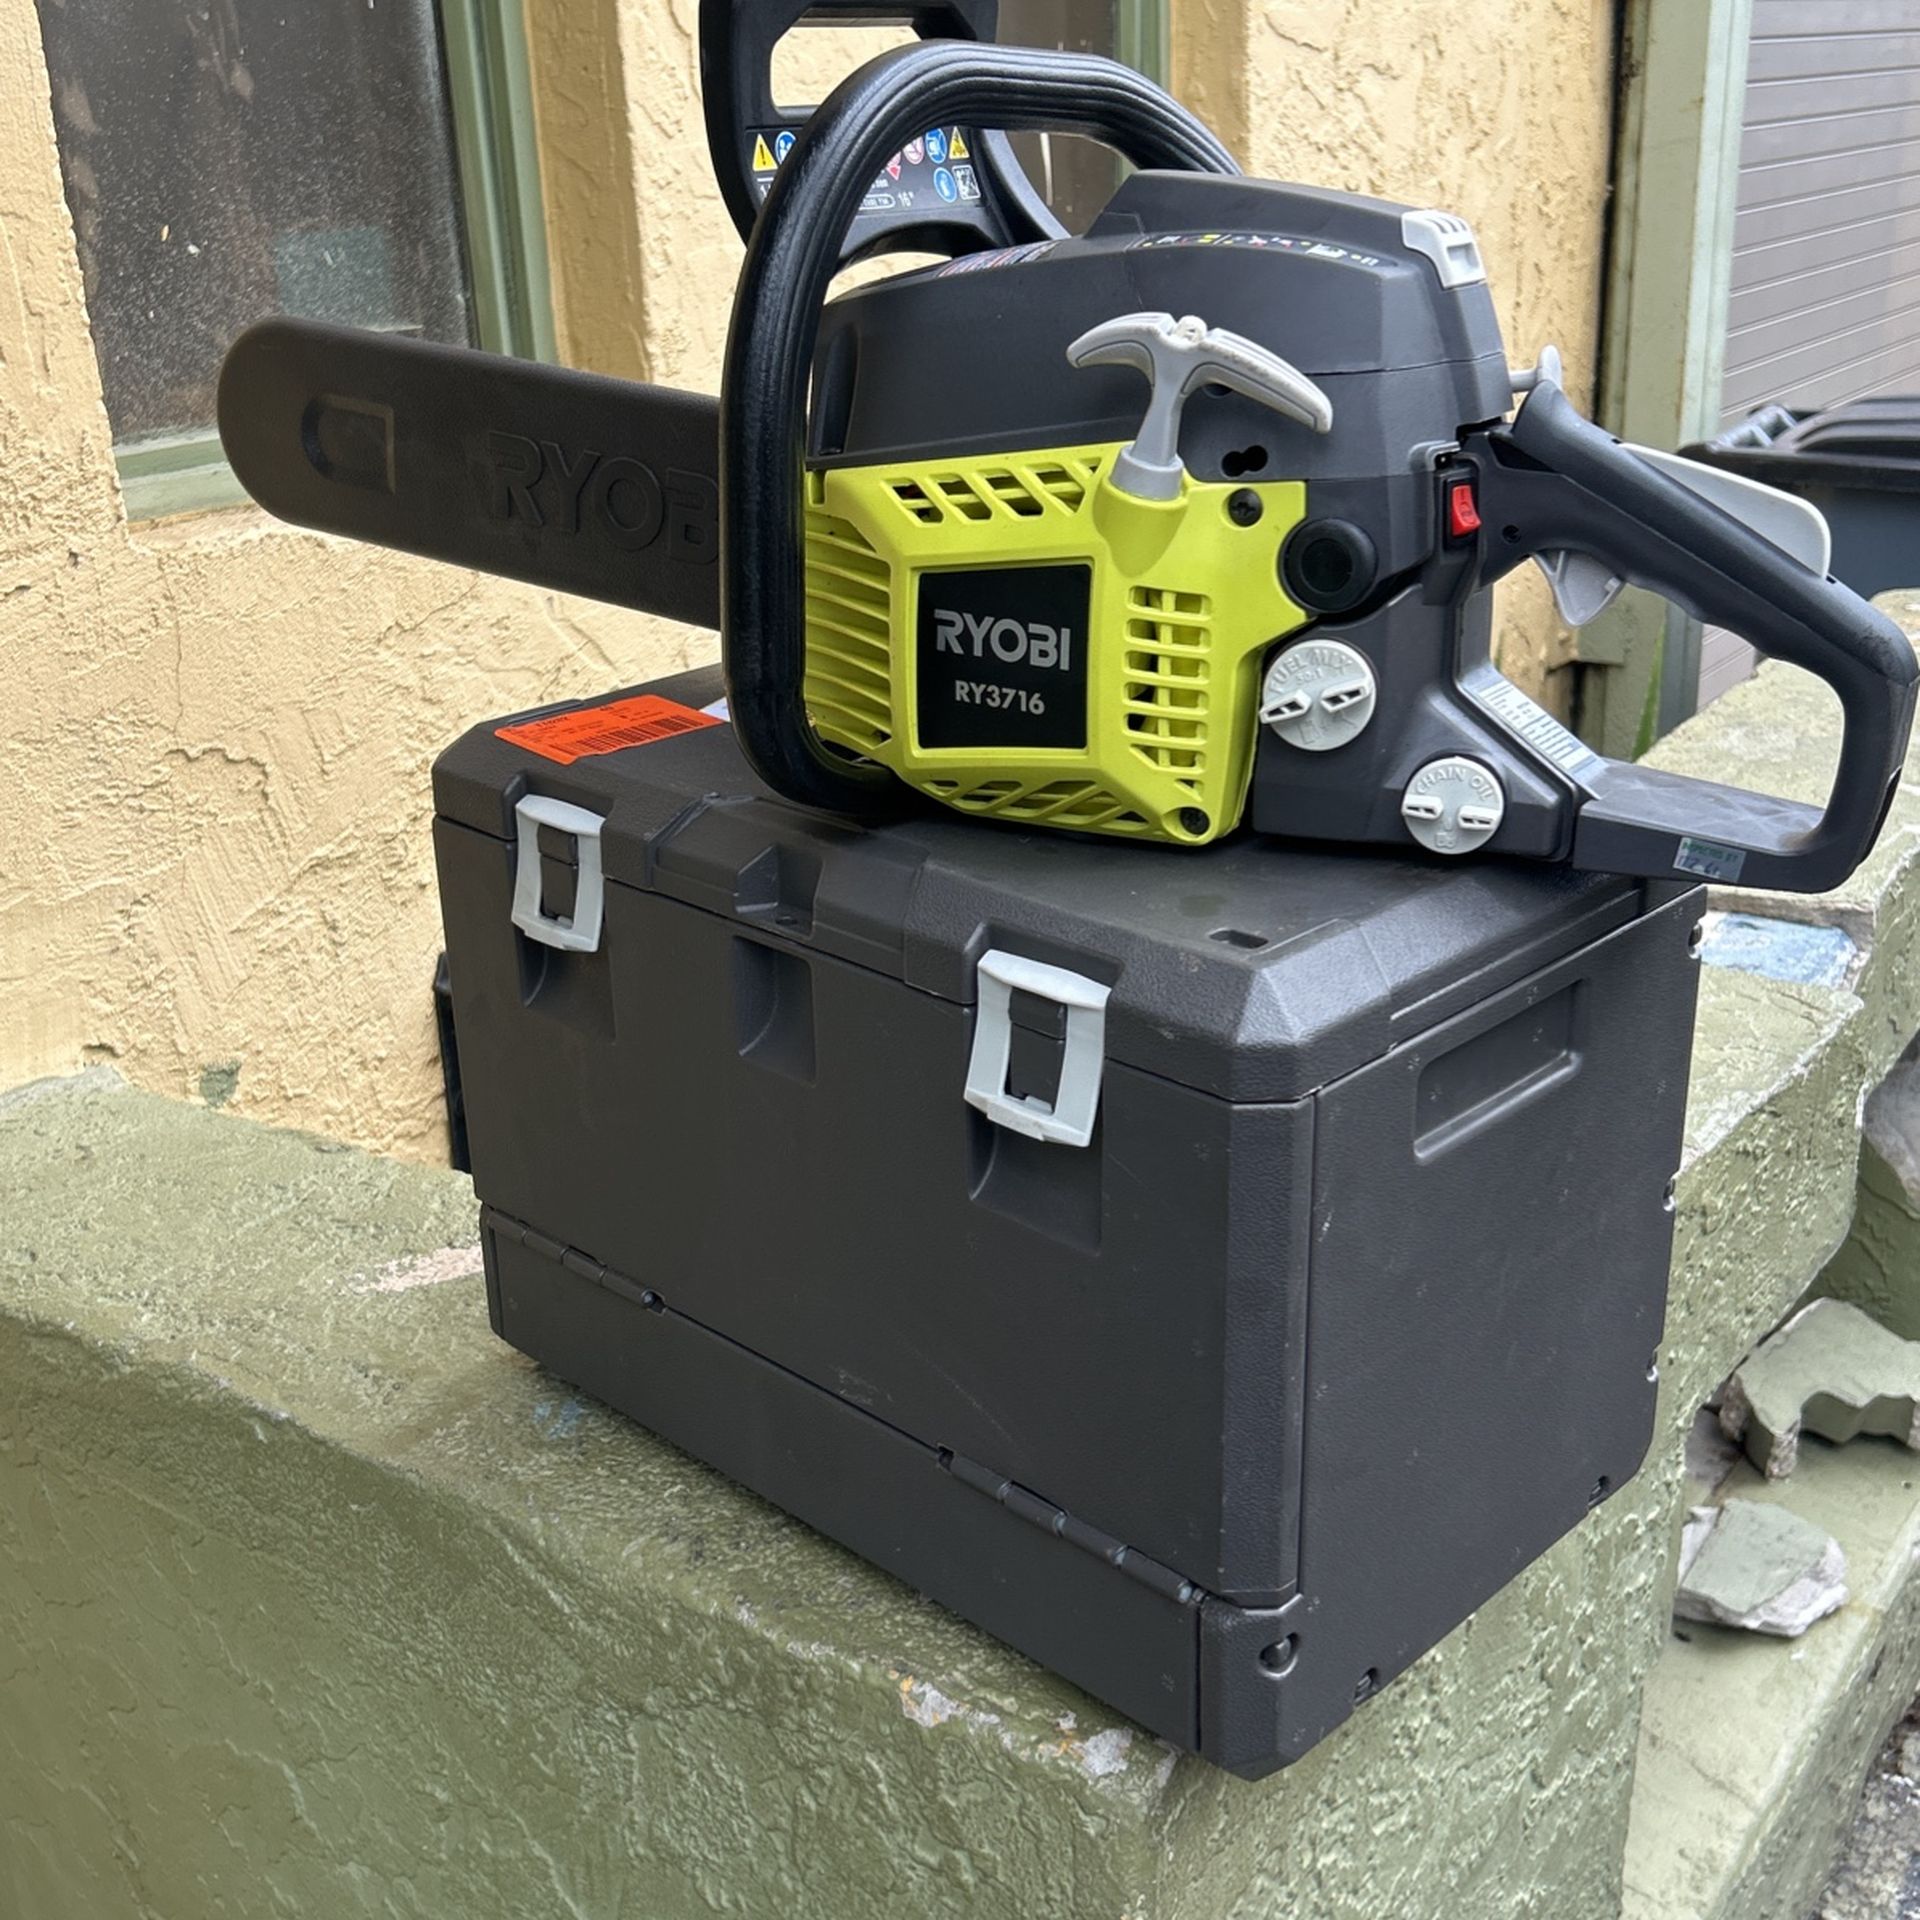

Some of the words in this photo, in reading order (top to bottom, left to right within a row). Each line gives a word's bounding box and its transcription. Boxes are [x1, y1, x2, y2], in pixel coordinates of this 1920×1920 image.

[489, 431, 719, 565] RYOB
[934, 608, 1071, 671] RYOBI
[1269, 653, 1308, 695] FUEL
[955, 680, 1045, 715] RY3716
[1415, 766, 1466, 795] CHAIN
[1469, 775, 1494, 801] OIL
